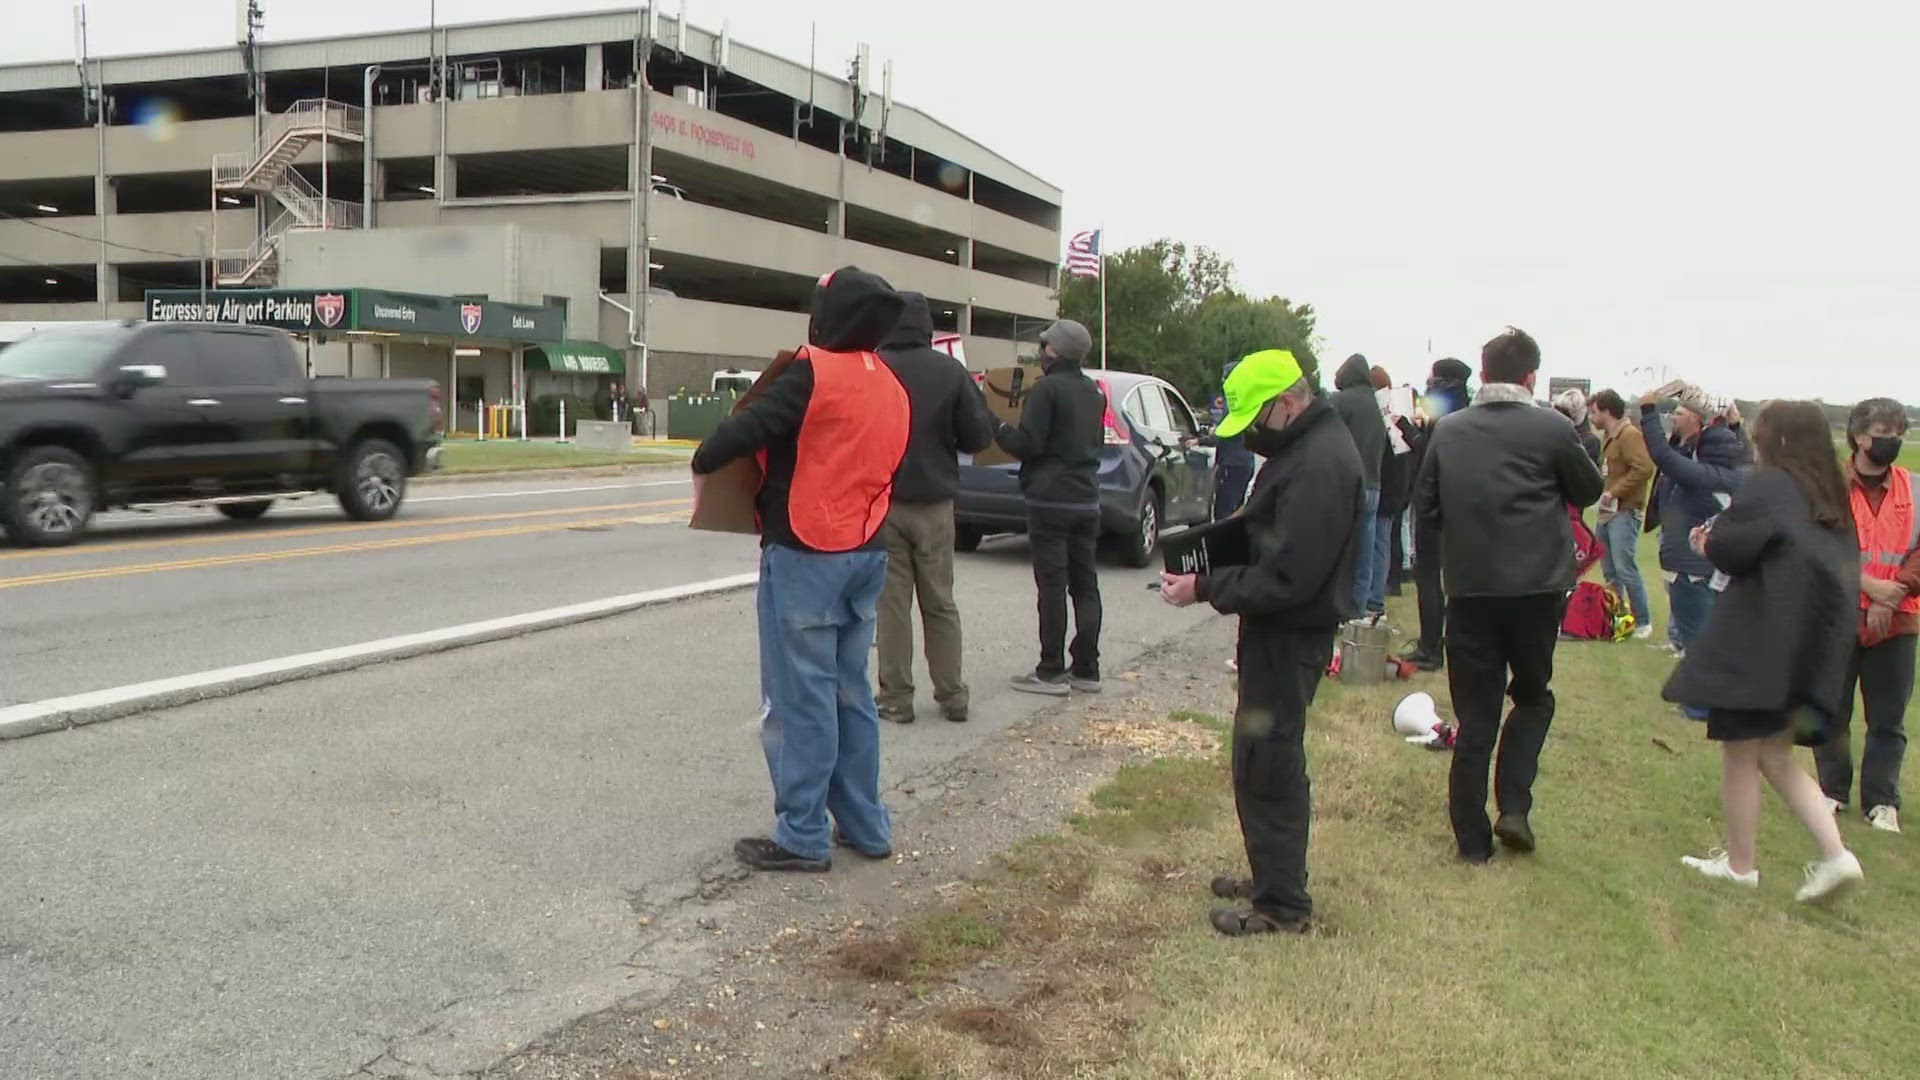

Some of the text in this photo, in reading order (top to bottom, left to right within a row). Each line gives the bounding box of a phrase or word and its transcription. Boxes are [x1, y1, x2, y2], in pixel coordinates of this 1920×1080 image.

[222, 298, 263, 321] Airort
[266, 298, 312, 326] Parking
[374, 304, 416, 323] Uncovered Entry
[512, 315, 522, 328] Exit
